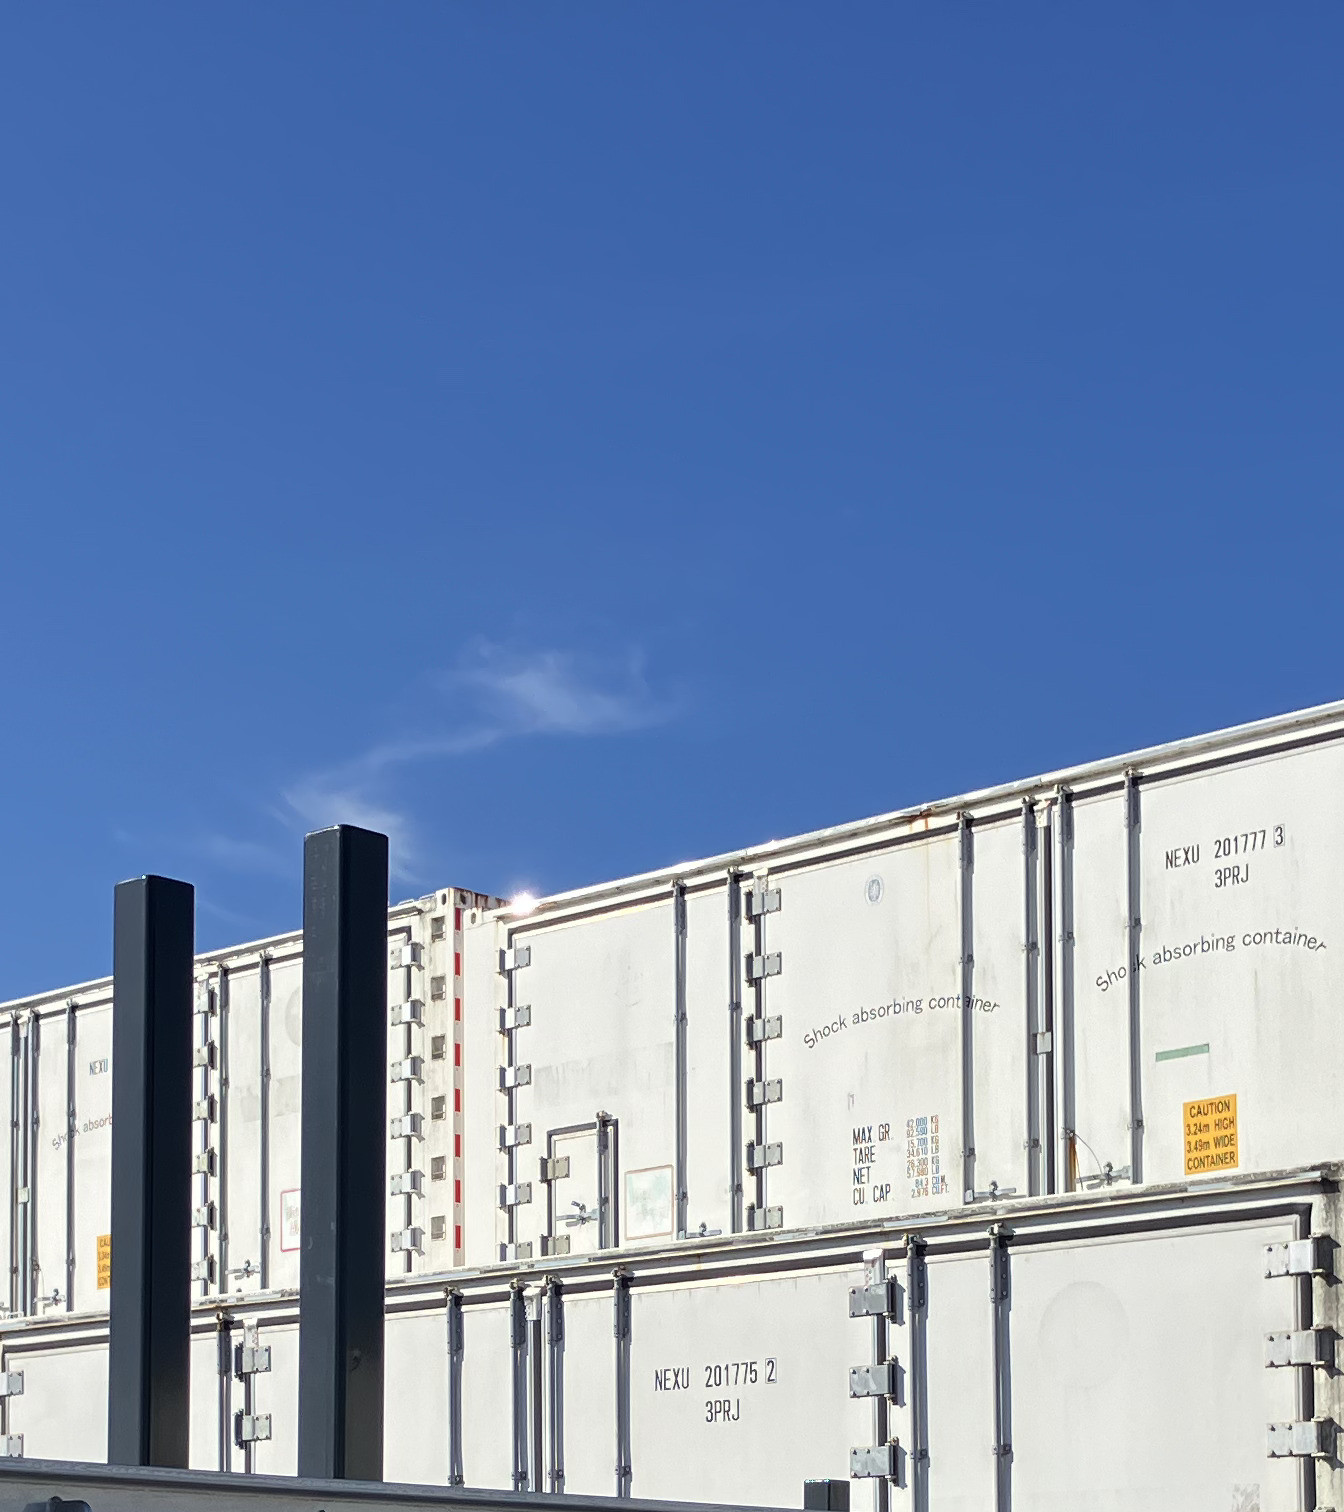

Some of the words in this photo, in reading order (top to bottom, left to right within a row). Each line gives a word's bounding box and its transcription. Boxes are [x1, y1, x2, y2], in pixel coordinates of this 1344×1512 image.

[1165, 843, 1201, 870] NEXU
[1214, 829, 1267, 859] 201777
[1274, 826, 1285, 846] 3
[1214, 863, 1250, 888] 3PRJ
[1152, 934, 1235, 966] absorbing
[1242, 926, 1327, 952] container
[803, 1014, 848, 1049] Shock
[852, 996, 924, 1025] absorbing
[89, 1058, 109, 1076] NEXU
[1189, 1099, 1231, 1118] CAUTION
[83, 1113, 113, 1133] absorb
[1214, 1116, 1235, 1132] HIGH
[1213, 1134, 1236, 1149] WIDE
[853, 1145, 876, 1166] TARE
[1187, 1151, 1236, 1171] CONTAINER
[853, 1166, 871, 1186] NET
[654, 1367, 690, 1391] NEXU
[705, 1361, 758, 1388] 201775
[766, 1359, 775, 1382] 2
[705, 1398, 740, 1423] 3PRJ
